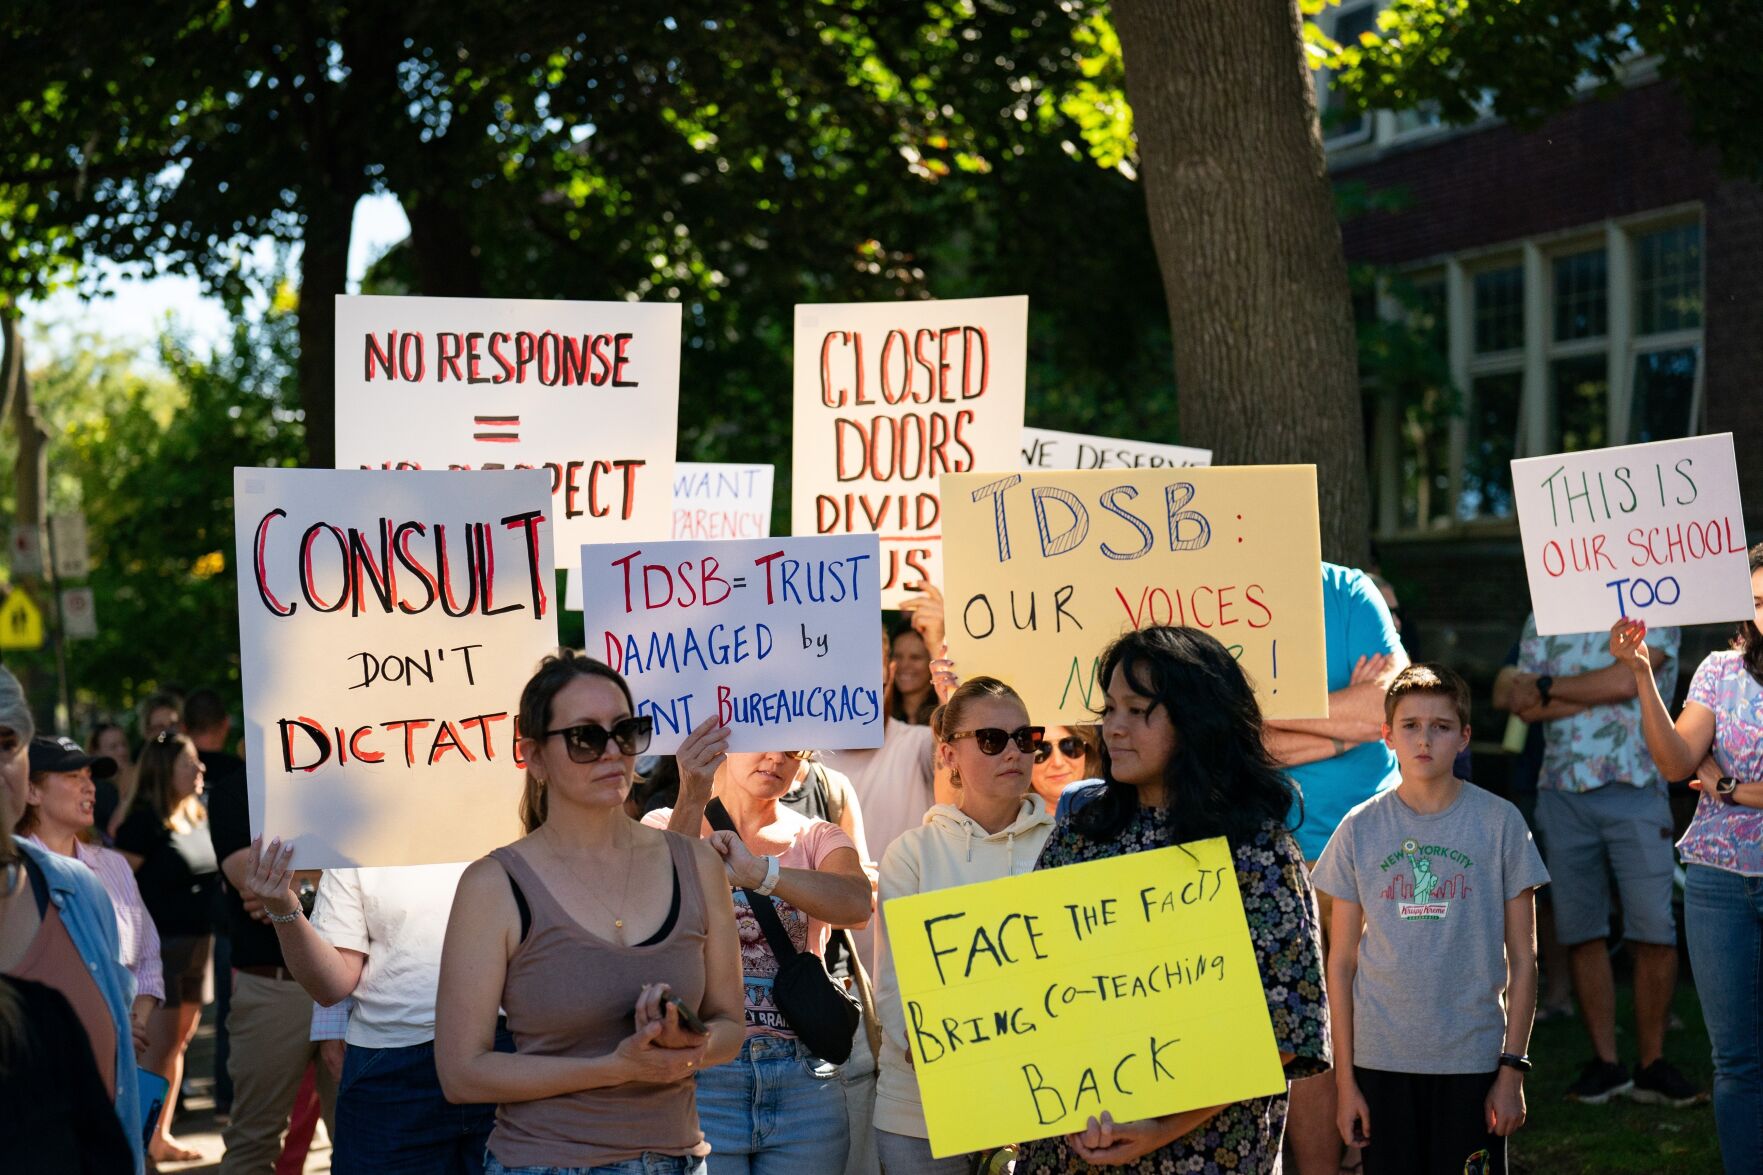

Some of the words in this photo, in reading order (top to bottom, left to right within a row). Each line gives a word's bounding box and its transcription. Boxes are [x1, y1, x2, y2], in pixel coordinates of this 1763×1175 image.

[363, 328, 425, 383] NO
[437, 329, 639, 388] RESPONSE
[819, 325, 990, 409] CLOSED
[834, 409, 976, 482] DOORS
[1076, 443, 1206, 469] DESER
[673, 468, 761, 498] WANT
[1541, 465, 1638, 527] THIS
[1656, 458, 1698, 507] IS
[671, 508, 764, 540] PARENCY
[816, 492, 941, 534] DIVID
[254, 508, 546, 620] CONSULT
[1542, 534, 1617, 577] OUR
[1627, 516, 1747, 567] SCHOOL
[754, 550, 870, 605] TRUST
[1606, 576, 1681, 617] TOO
[963, 585, 1084, 640] OUR
[1115, 583, 1273, 630] VOICES
[347, 644, 483, 689] DON'T
[604, 623, 773, 676] DAMAGED
[800, 623, 829, 658] by
[717, 684, 879, 729] BUREAUCRACY
[1380, 849, 1405, 872] NEW
[1418, 845, 1449, 858] YORK
[1449, 849, 1474, 869] CITY
[923, 911, 1048, 986] FACE
[1064, 898, 1118, 941] THE
[1139, 867, 1227, 923] FACTS
[907, 1000, 1037, 1064] BRING
[1021, 1036, 1181, 1125] BACK
